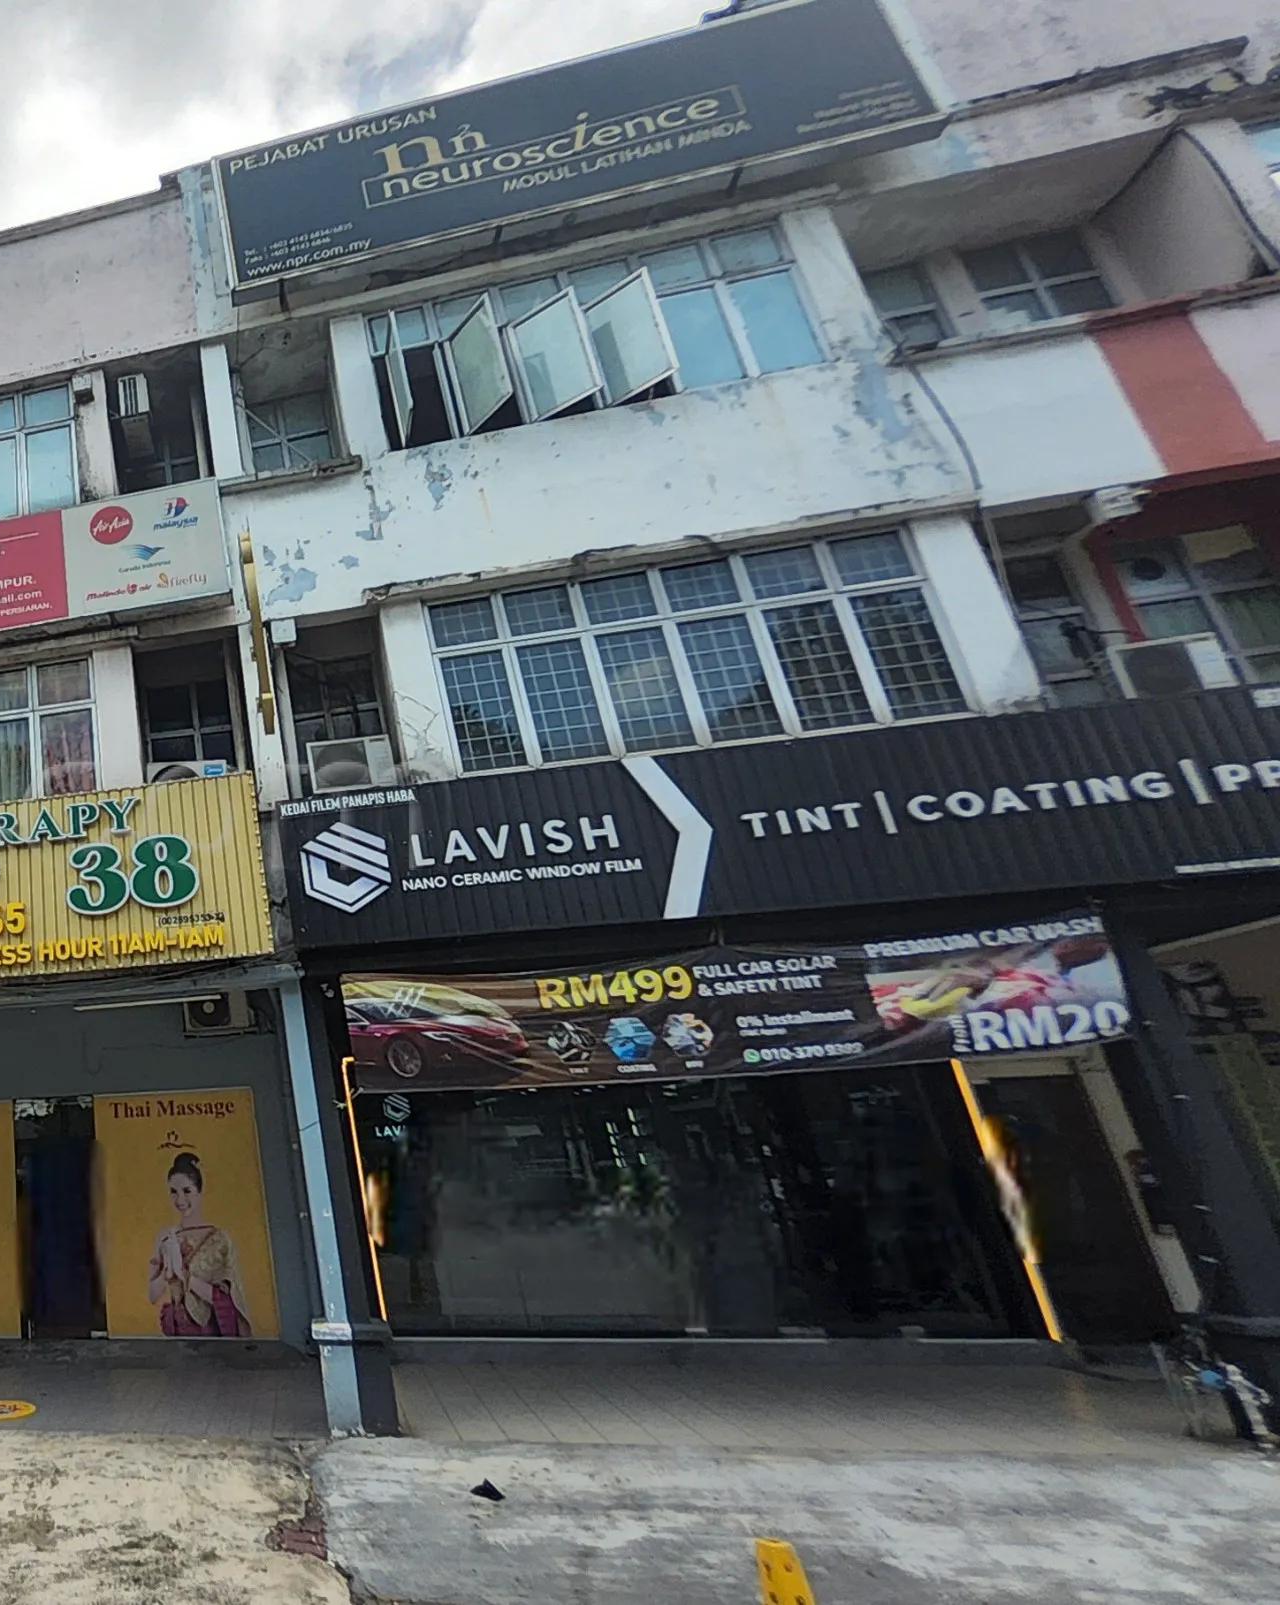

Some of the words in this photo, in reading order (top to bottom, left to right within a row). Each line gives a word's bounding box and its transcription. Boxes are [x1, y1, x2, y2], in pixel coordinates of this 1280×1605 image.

[230, 134, 329, 175] PEJABAT
[337, 106, 437, 144] URUSAN
[383, 96, 721, 199] neuroscience
[503, 163, 578, 193] MODUL
[581, 137, 672, 173] LATIHAN
[246, 238, 372, 278] www.npr.com.my
[153, 516, 199, 531] malaysia
[170, 573, 208, 588] firefly
[280, 801, 310, 818] KEDAI
[311, 796, 341, 814] FILEM
[386, 788, 416, 804] HABA
[740, 801, 863, 838] TINT
[906, 770, 1176, 822] COATING
[411, 814, 622, 867] LAVISH
[66, 834, 200, 917] 38
[402, 875, 448, 892] NANO
[451, 868, 523, 889] CERAMIC
[525, 861, 602, 882] WINDOW
[605, 857, 643, 873] FILM
[37, 934, 103, 962] HOUR
[108, 925, 225, 957] 11AM-1AM
[863, 933, 979, 958] PREMIUM
[979, 926, 1032, 947] CAR
[692, 964, 737, 980] FULL
[738, 960, 774, 976] CAR
[776, 955, 837, 973] SOLAR
[697, 981, 713, 996] &
[714, 977, 781, 996] SAFETY
[782, 973, 822, 992] TINT
[534, 965, 692, 1010] RM499
[764, 1009, 855, 1026] installment
[967, 1002, 1130, 1054] RM20
[110, 1101, 150, 1120] Thai
[156, 1098, 236, 1120] Massage
